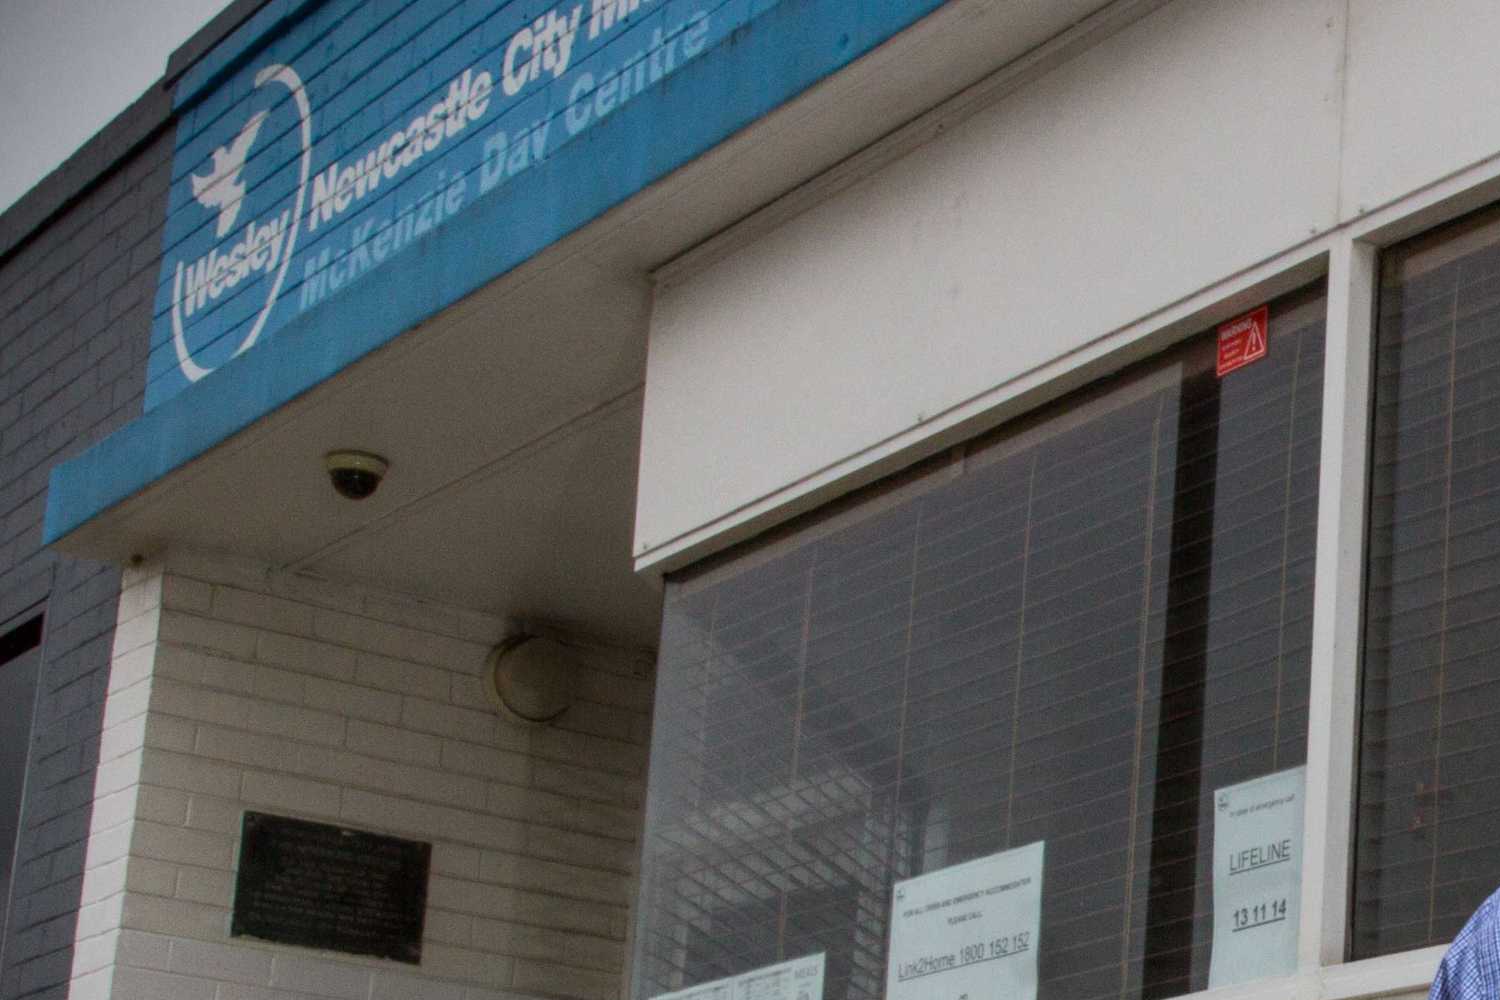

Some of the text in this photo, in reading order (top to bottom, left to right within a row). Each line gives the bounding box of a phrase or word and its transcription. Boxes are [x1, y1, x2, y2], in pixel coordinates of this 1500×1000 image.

[307, 4, 581, 232] Newcastle City
[301, 168, 468, 311] McKenzie
[565, 10, 709, 135] Centre
[184, 208, 290, 318] Wesley
[1229, 839, 1291, 872] LIFELINE
[1233, 898, 1286, 928] 13 11 14
[897, 930, 1030, 979] Link2Home 1800 152 152
